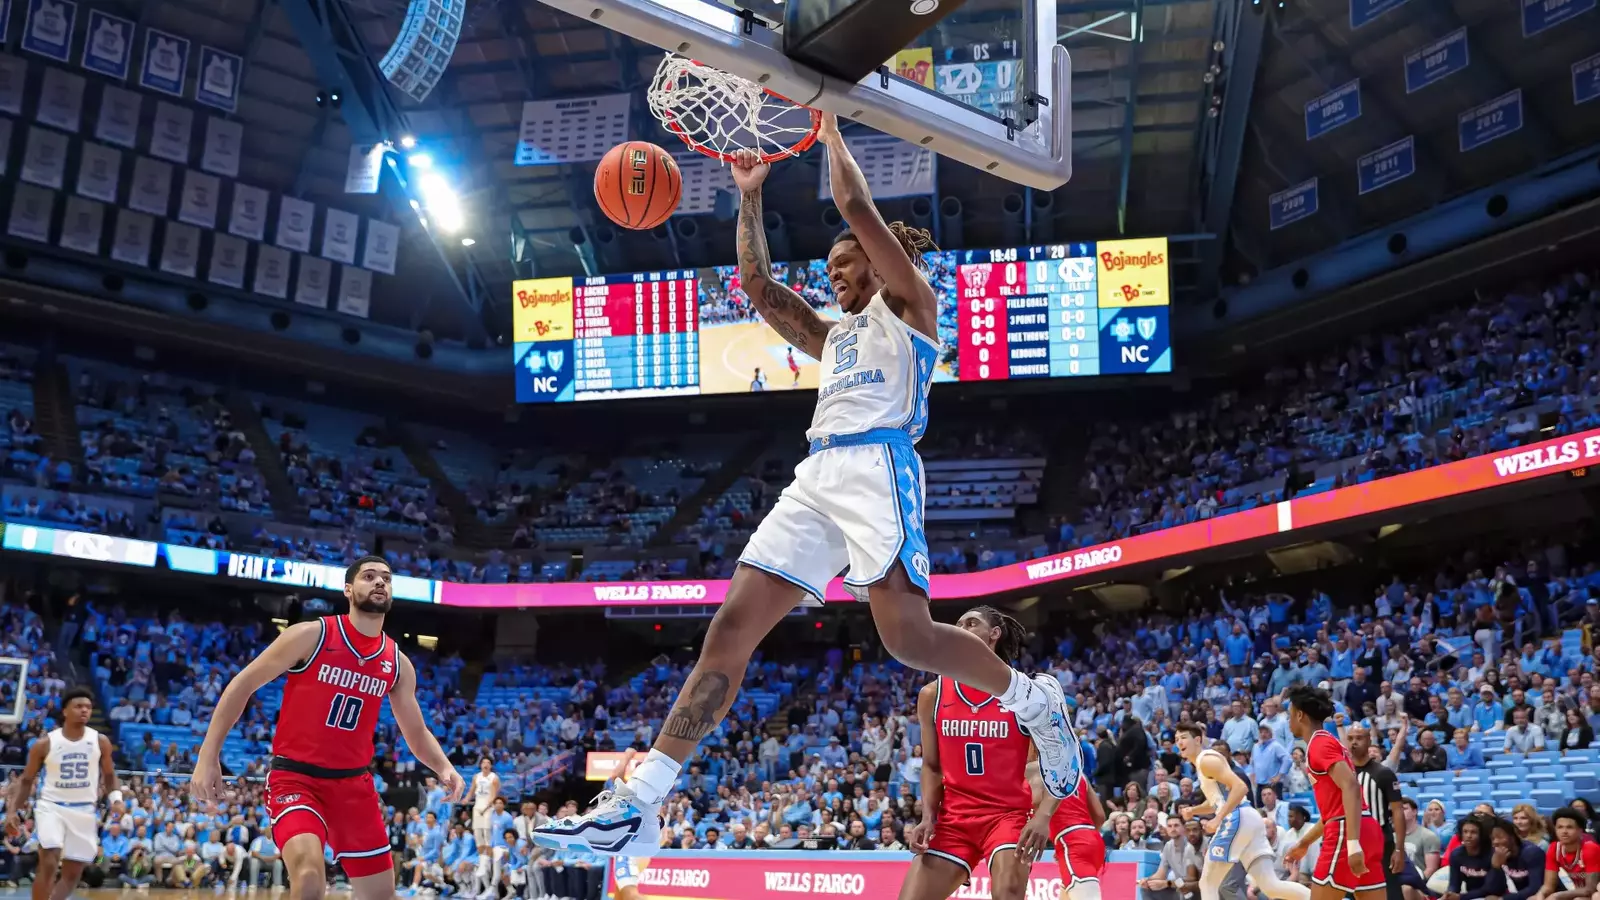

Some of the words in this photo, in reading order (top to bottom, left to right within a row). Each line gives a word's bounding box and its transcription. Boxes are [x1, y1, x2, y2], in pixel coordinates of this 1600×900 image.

[989, 248, 1018, 262] 19:49
[1051, 245, 1065, 259] 20
[1100, 250, 1164, 271] Bojangles
[1005, 263, 1017, 285] 0
[1036, 261, 1048, 283] 0
[517, 289, 570, 309] Bojangles
[970, 298, 995, 313] 0-0
[1060, 293, 1085, 307] 0-0
[971, 314, 995, 329] 0-0
[1061, 310, 1085, 324] 0-0
[971, 331, 996, 346] 0-0
[1061, 326, 1085, 341] 0-0
[832, 333, 858, 375] 5
[979, 348, 989, 362] 0
[1069, 343, 1079, 358] 0
[1121, 345, 1149, 363] NC
[979, 364, 989, 379] 0
[1069, 360, 1079, 374] 0
[533, 376, 557, 394] NC
[1493, 441, 1580, 476] WELLS
[227, 553, 264, 580] DEAN
[1026, 557, 1072, 580] WELLS
[1074, 545, 1122, 570] FARGO
[593, 585, 649, 601] WELLS
[650, 584, 707, 600] FARGO
[317, 664, 387, 698] RADFORD
[325, 692, 364, 731] 10
[941, 719, 1009, 738] RADFORD
[964, 742, 985, 776] 0
[60, 761, 89, 779] 55
[670, 868, 710, 888] FARGO
[764, 871, 812, 892] WELLS
[813, 873, 865, 895] FARGO
[950, 877, 992, 899] ELL
[1025, 878, 1062, 900] ARG
